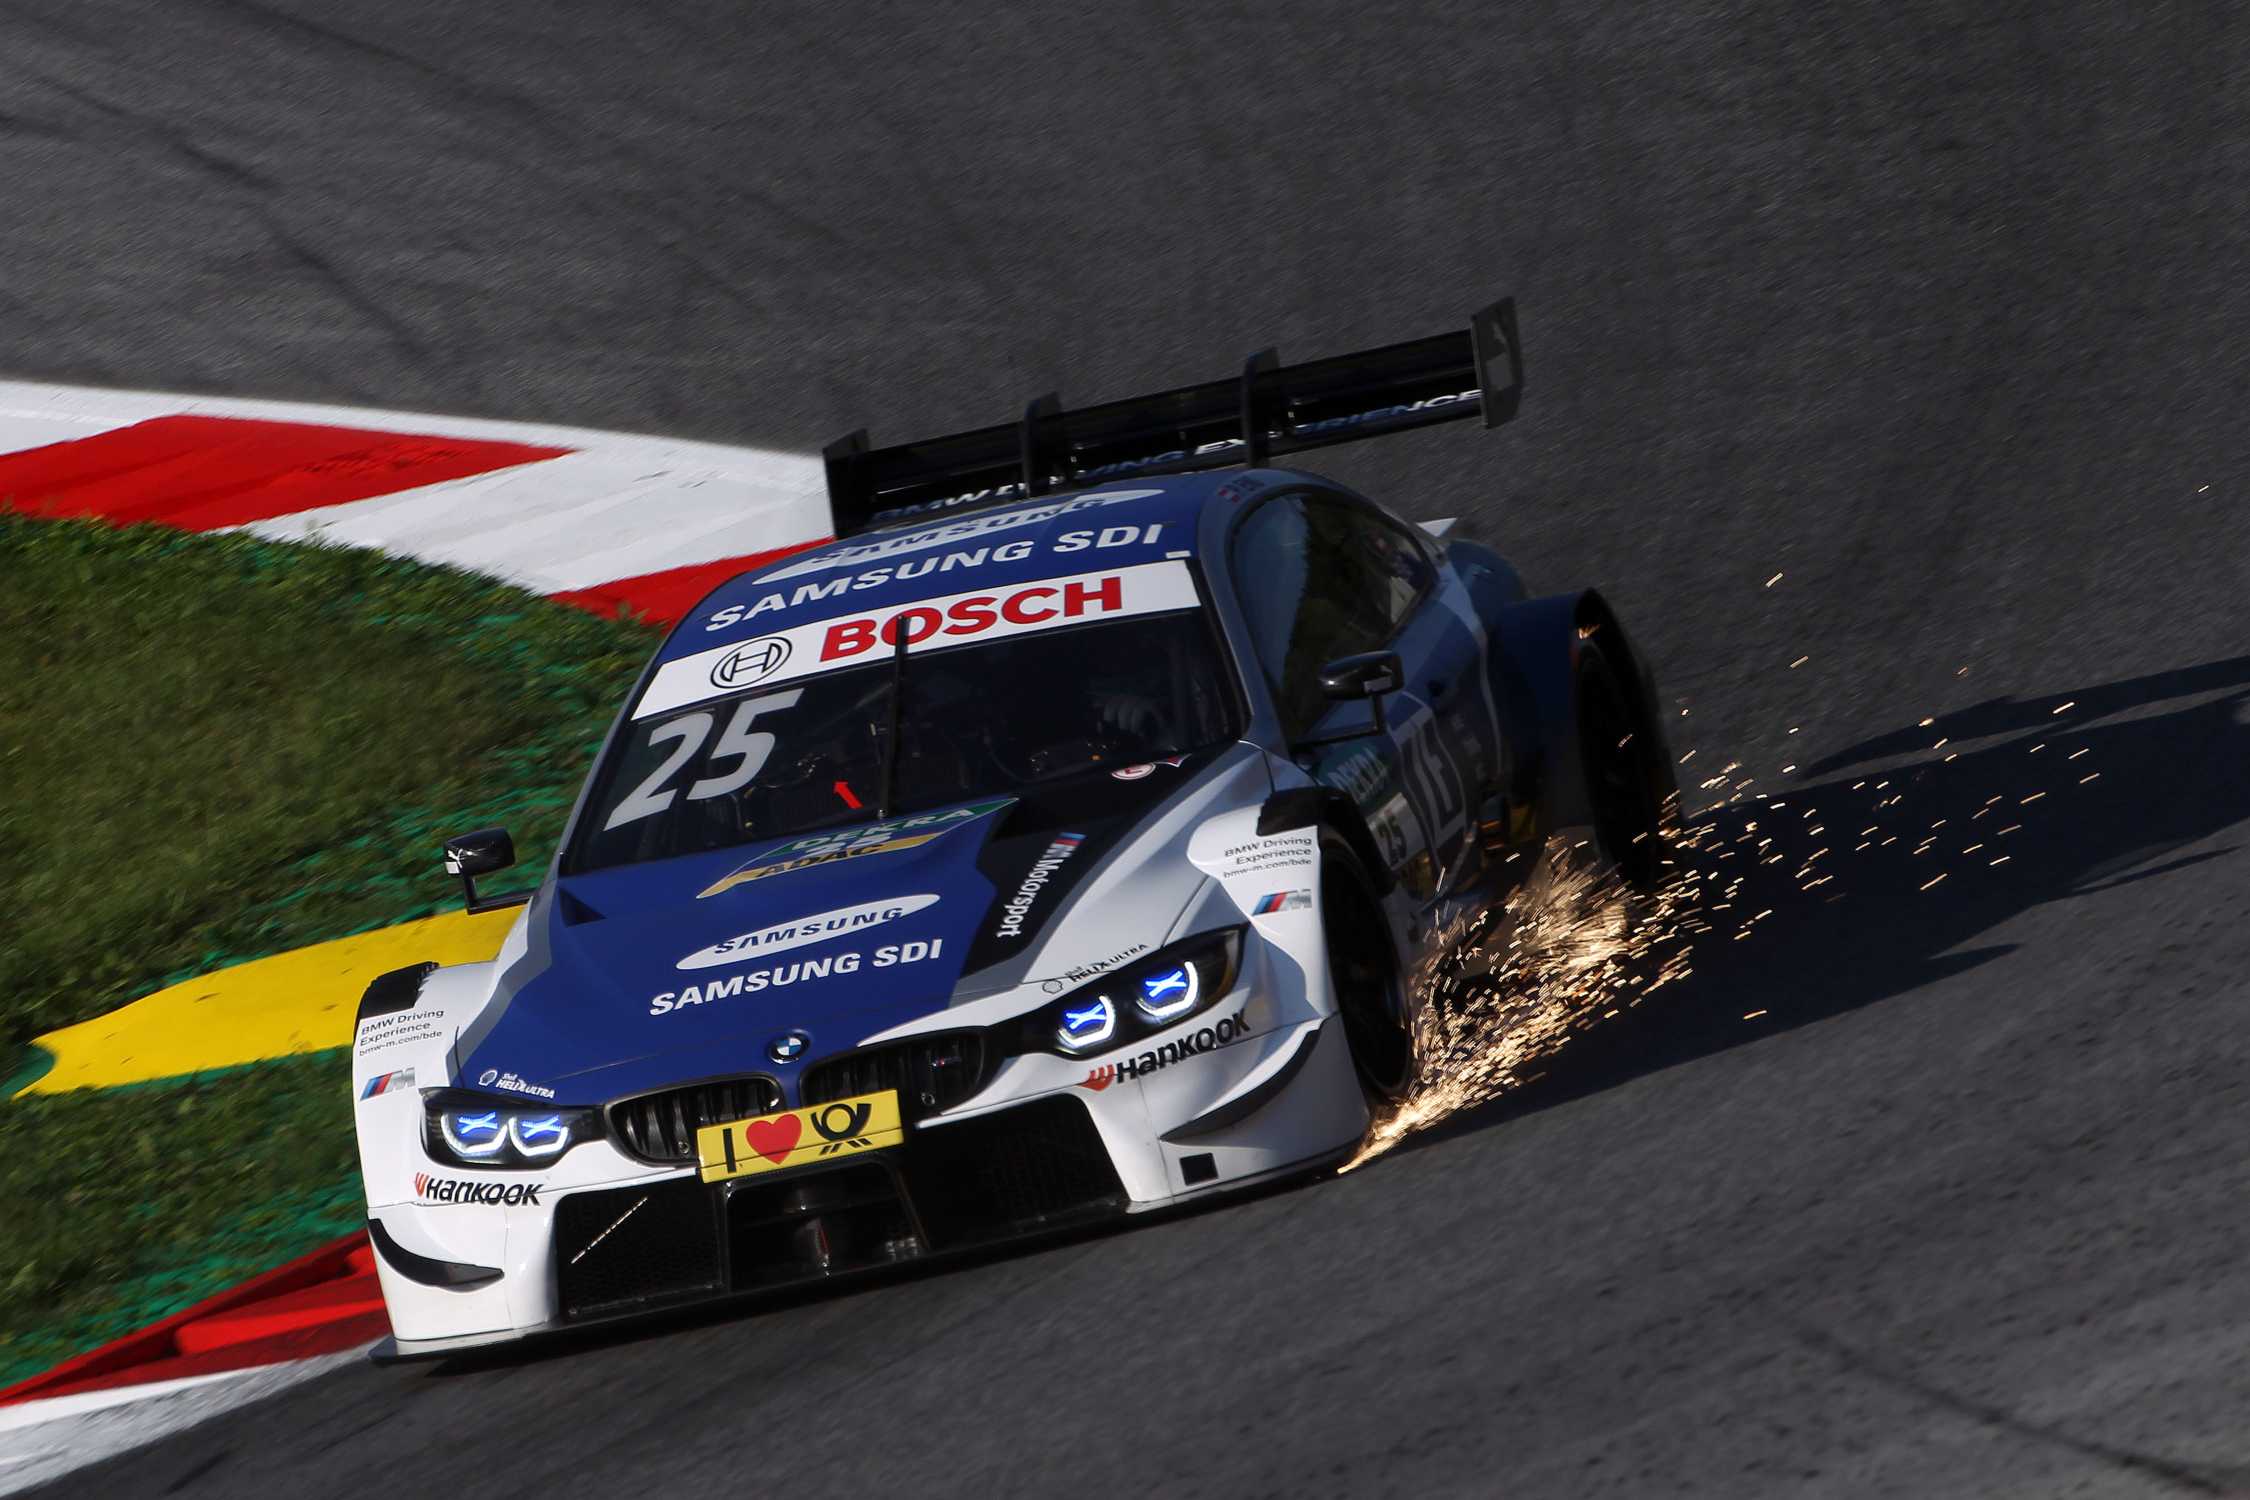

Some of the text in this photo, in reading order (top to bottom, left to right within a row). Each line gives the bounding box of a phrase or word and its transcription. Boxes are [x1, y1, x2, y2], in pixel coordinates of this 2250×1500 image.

[808, 496, 1110, 566] SAMSUNG
[705, 523, 1164, 632] SAMSUNG SDI
[819, 576, 1123, 662] BOSCH
[603, 688, 805, 834] 25
[791, 808, 976, 851] DEKRA
[1224, 836, 1312, 857] BMW Driving
[756, 843, 884, 878] ADAC
[1236, 848, 1312, 865] Experience
[996, 859, 1065, 938] Motorsport
[713, 907, 903, 954] SAMSUNG
[1109, 943, 1148, 964] ULTRA
[650, 938, 943, 1016] SAMSUNG SDI
[360, 1022, 432, 1047] Experience
[361, 1010, 445, 1036] BMW Driving
[525, 1085, 556, 1099] ULTRA
[723, 1126, 738, 1174] I
